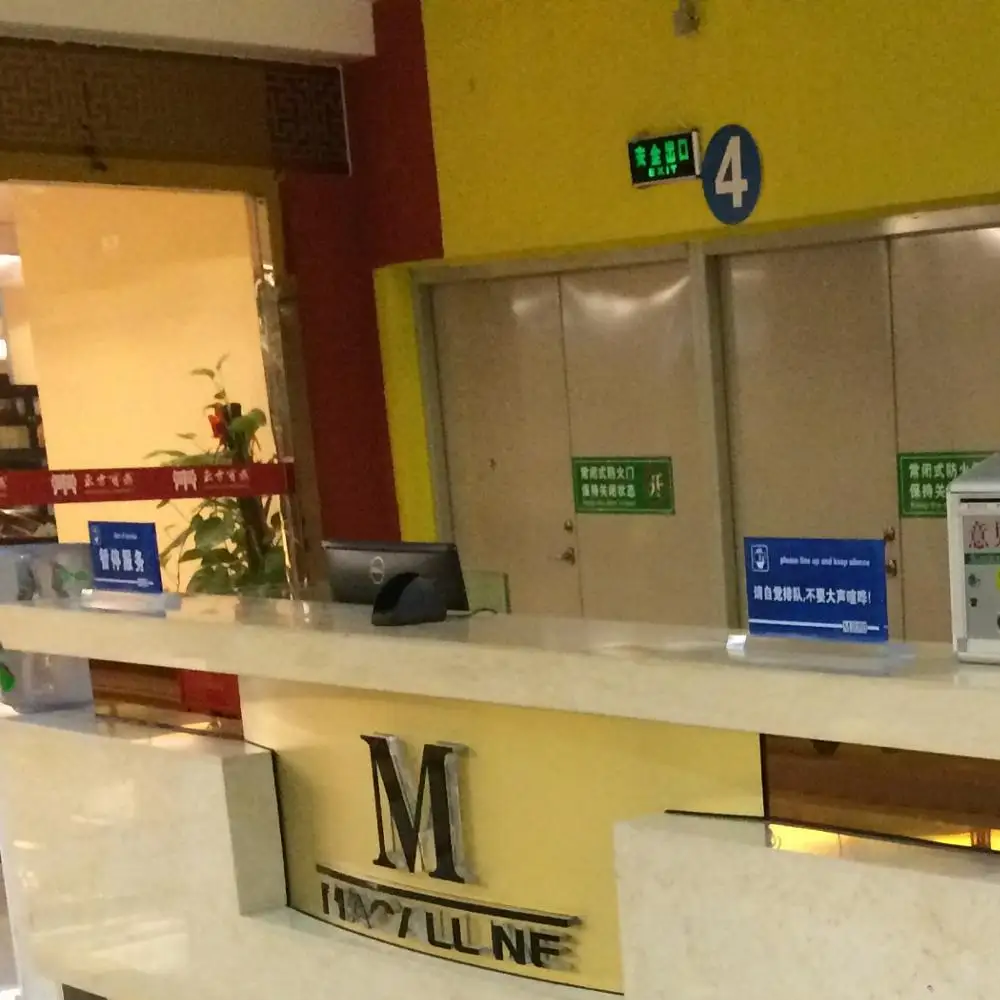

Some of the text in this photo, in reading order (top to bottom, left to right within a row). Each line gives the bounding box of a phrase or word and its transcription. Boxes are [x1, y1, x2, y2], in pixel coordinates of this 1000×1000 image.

[648, 164, 678, 178] EXIT
[715, 135, 748, 208] 4
[821, 557, 832, 566] and
[360, 733, 474, 883] M
